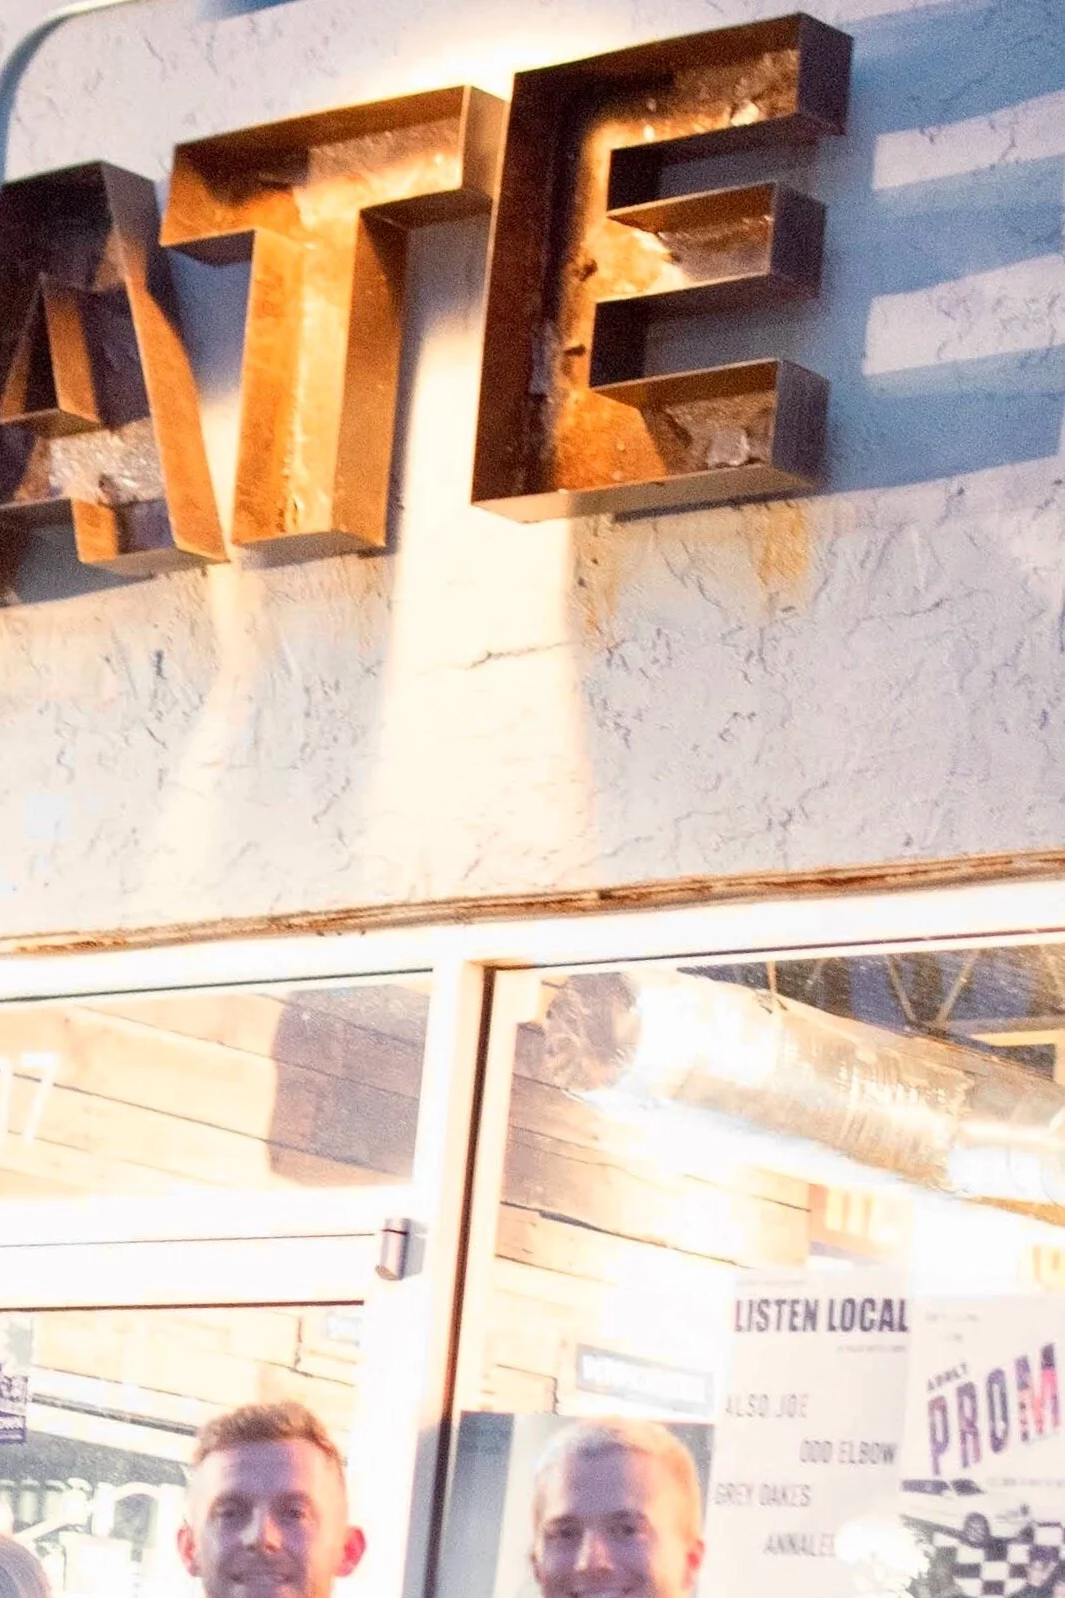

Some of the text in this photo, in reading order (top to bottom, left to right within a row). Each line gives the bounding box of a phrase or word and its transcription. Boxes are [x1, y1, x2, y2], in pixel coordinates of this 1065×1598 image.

[734, 1298, 909, 1333] LISTEN LOCAL
[928, 1343, 1060, 1475] PROM
[837, 1440, 897, 1465] ELBOW
